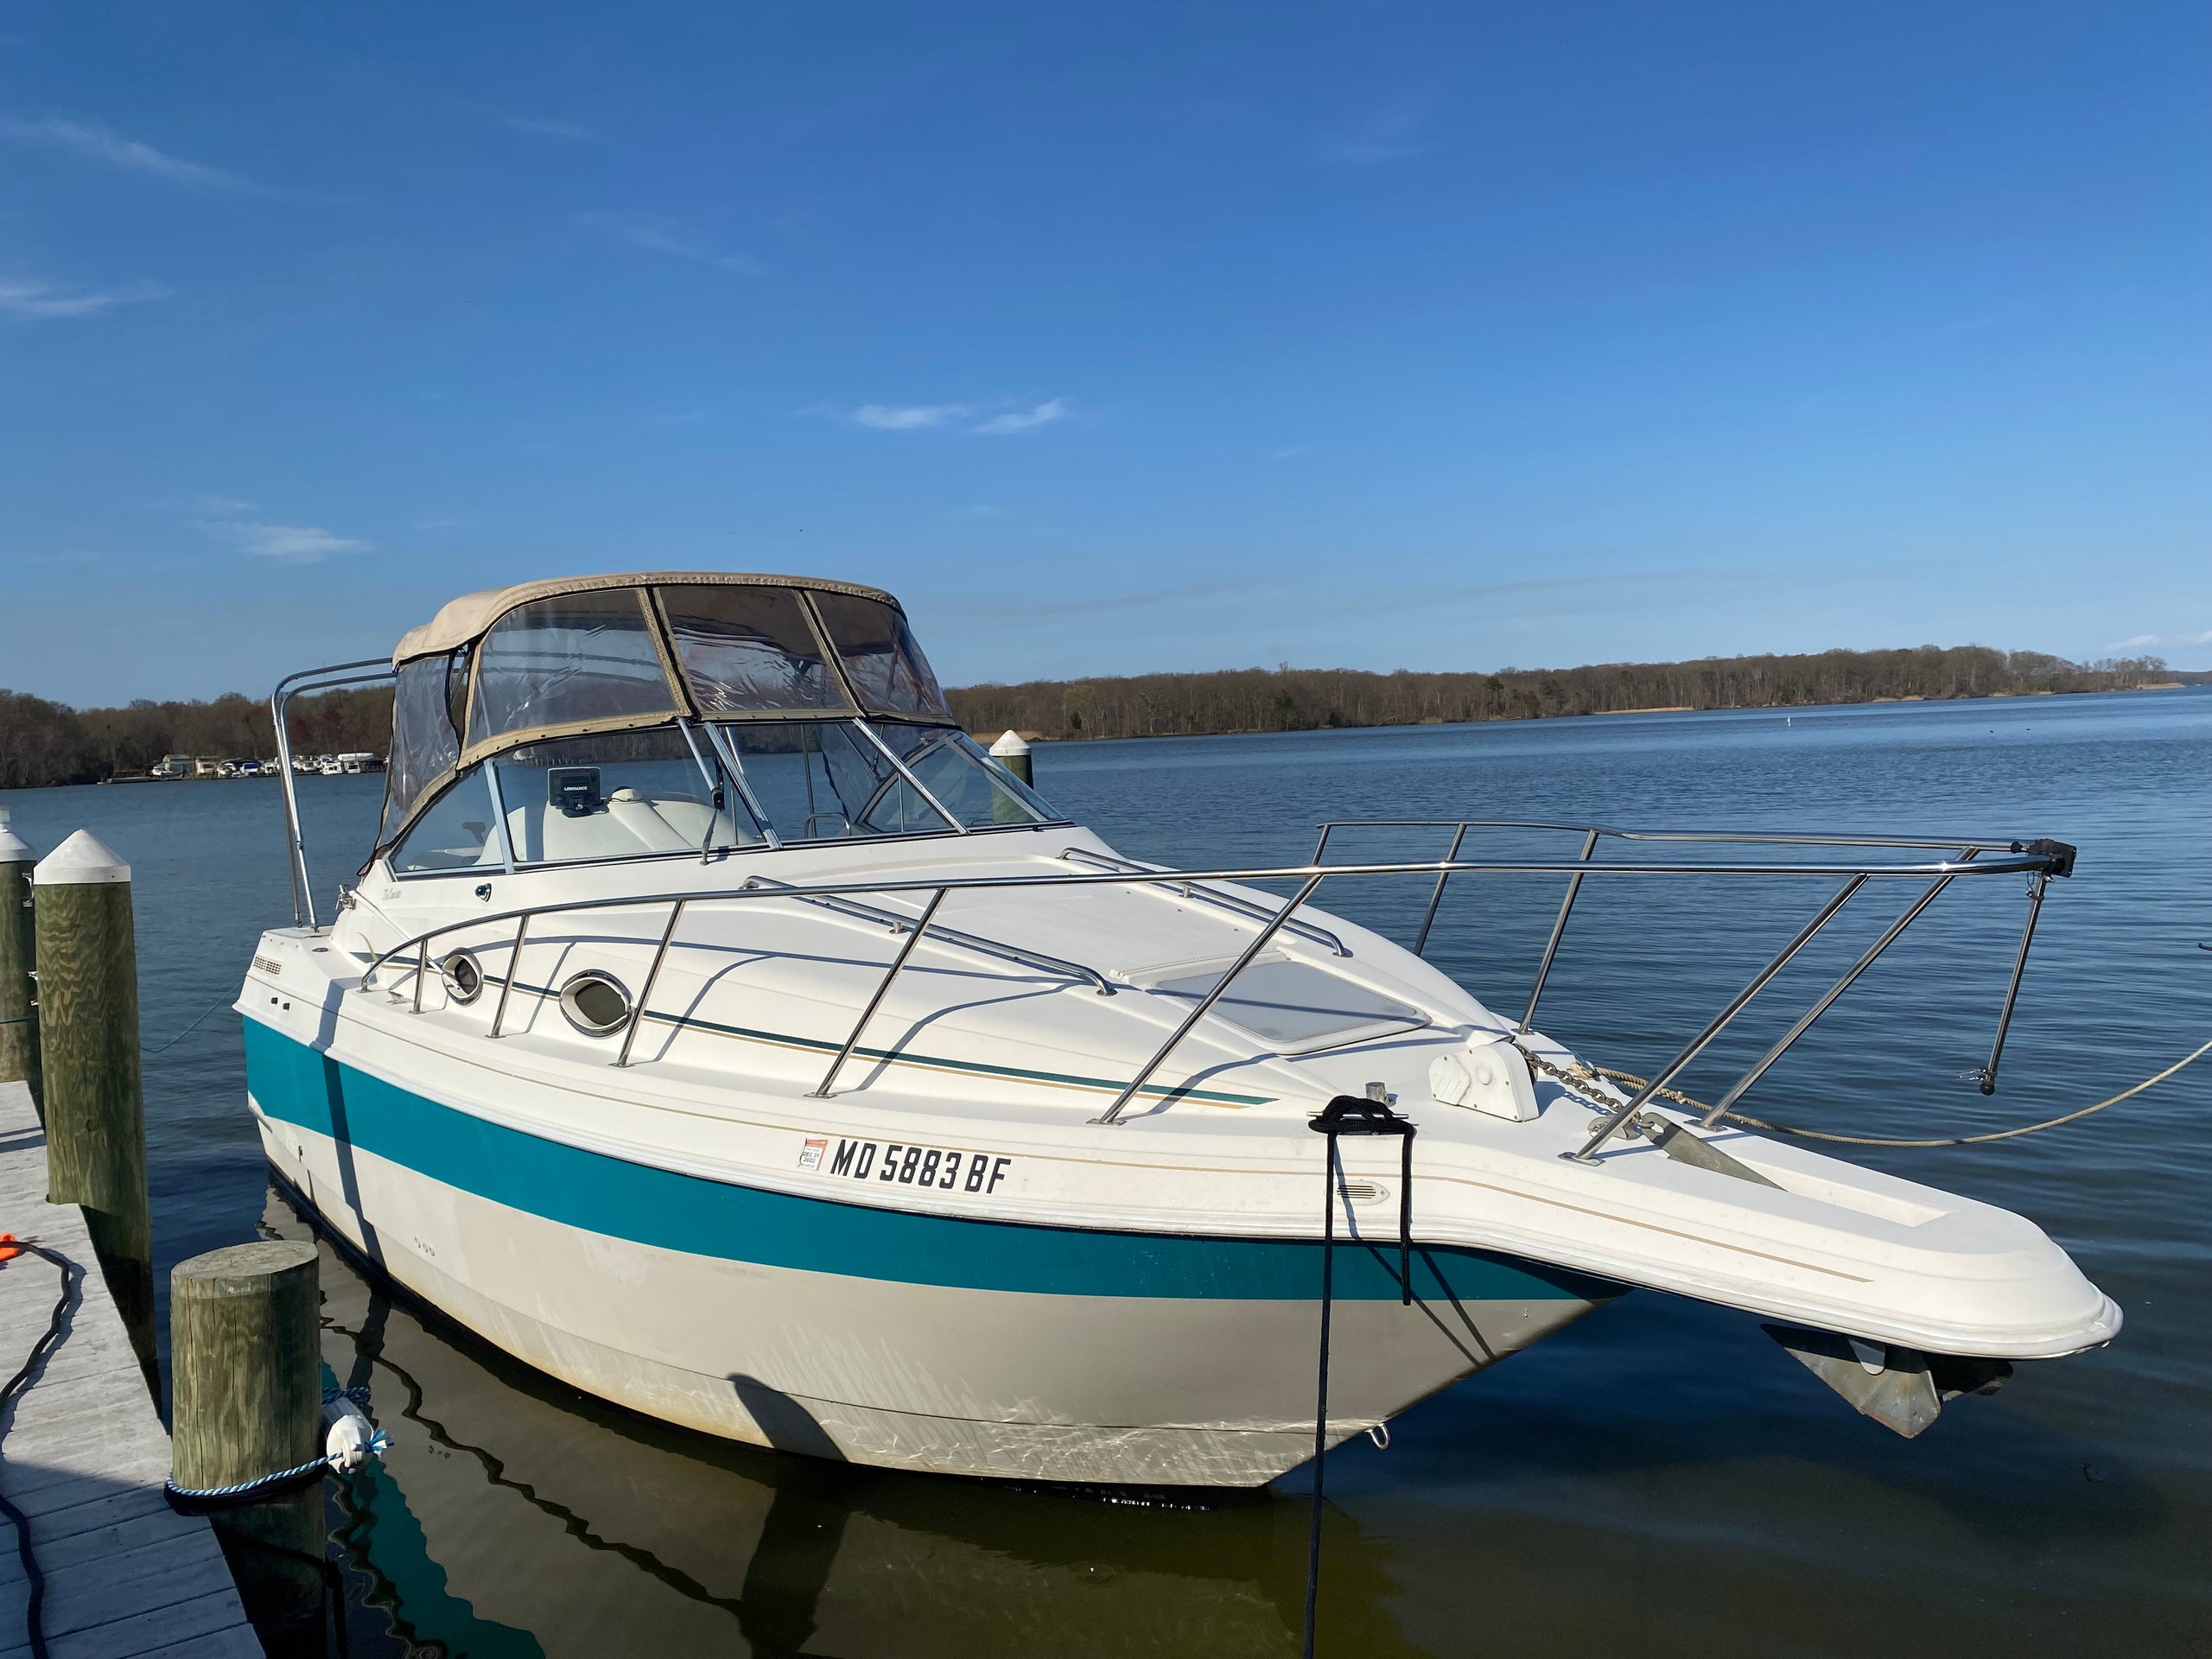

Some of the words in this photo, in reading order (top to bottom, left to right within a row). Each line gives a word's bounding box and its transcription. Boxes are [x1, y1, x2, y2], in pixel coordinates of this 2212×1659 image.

[830, 1139, 877, 1179] MD
[880, 1144, 962, 1190] 5883
[964, 1154, 1012, 1194] BF
